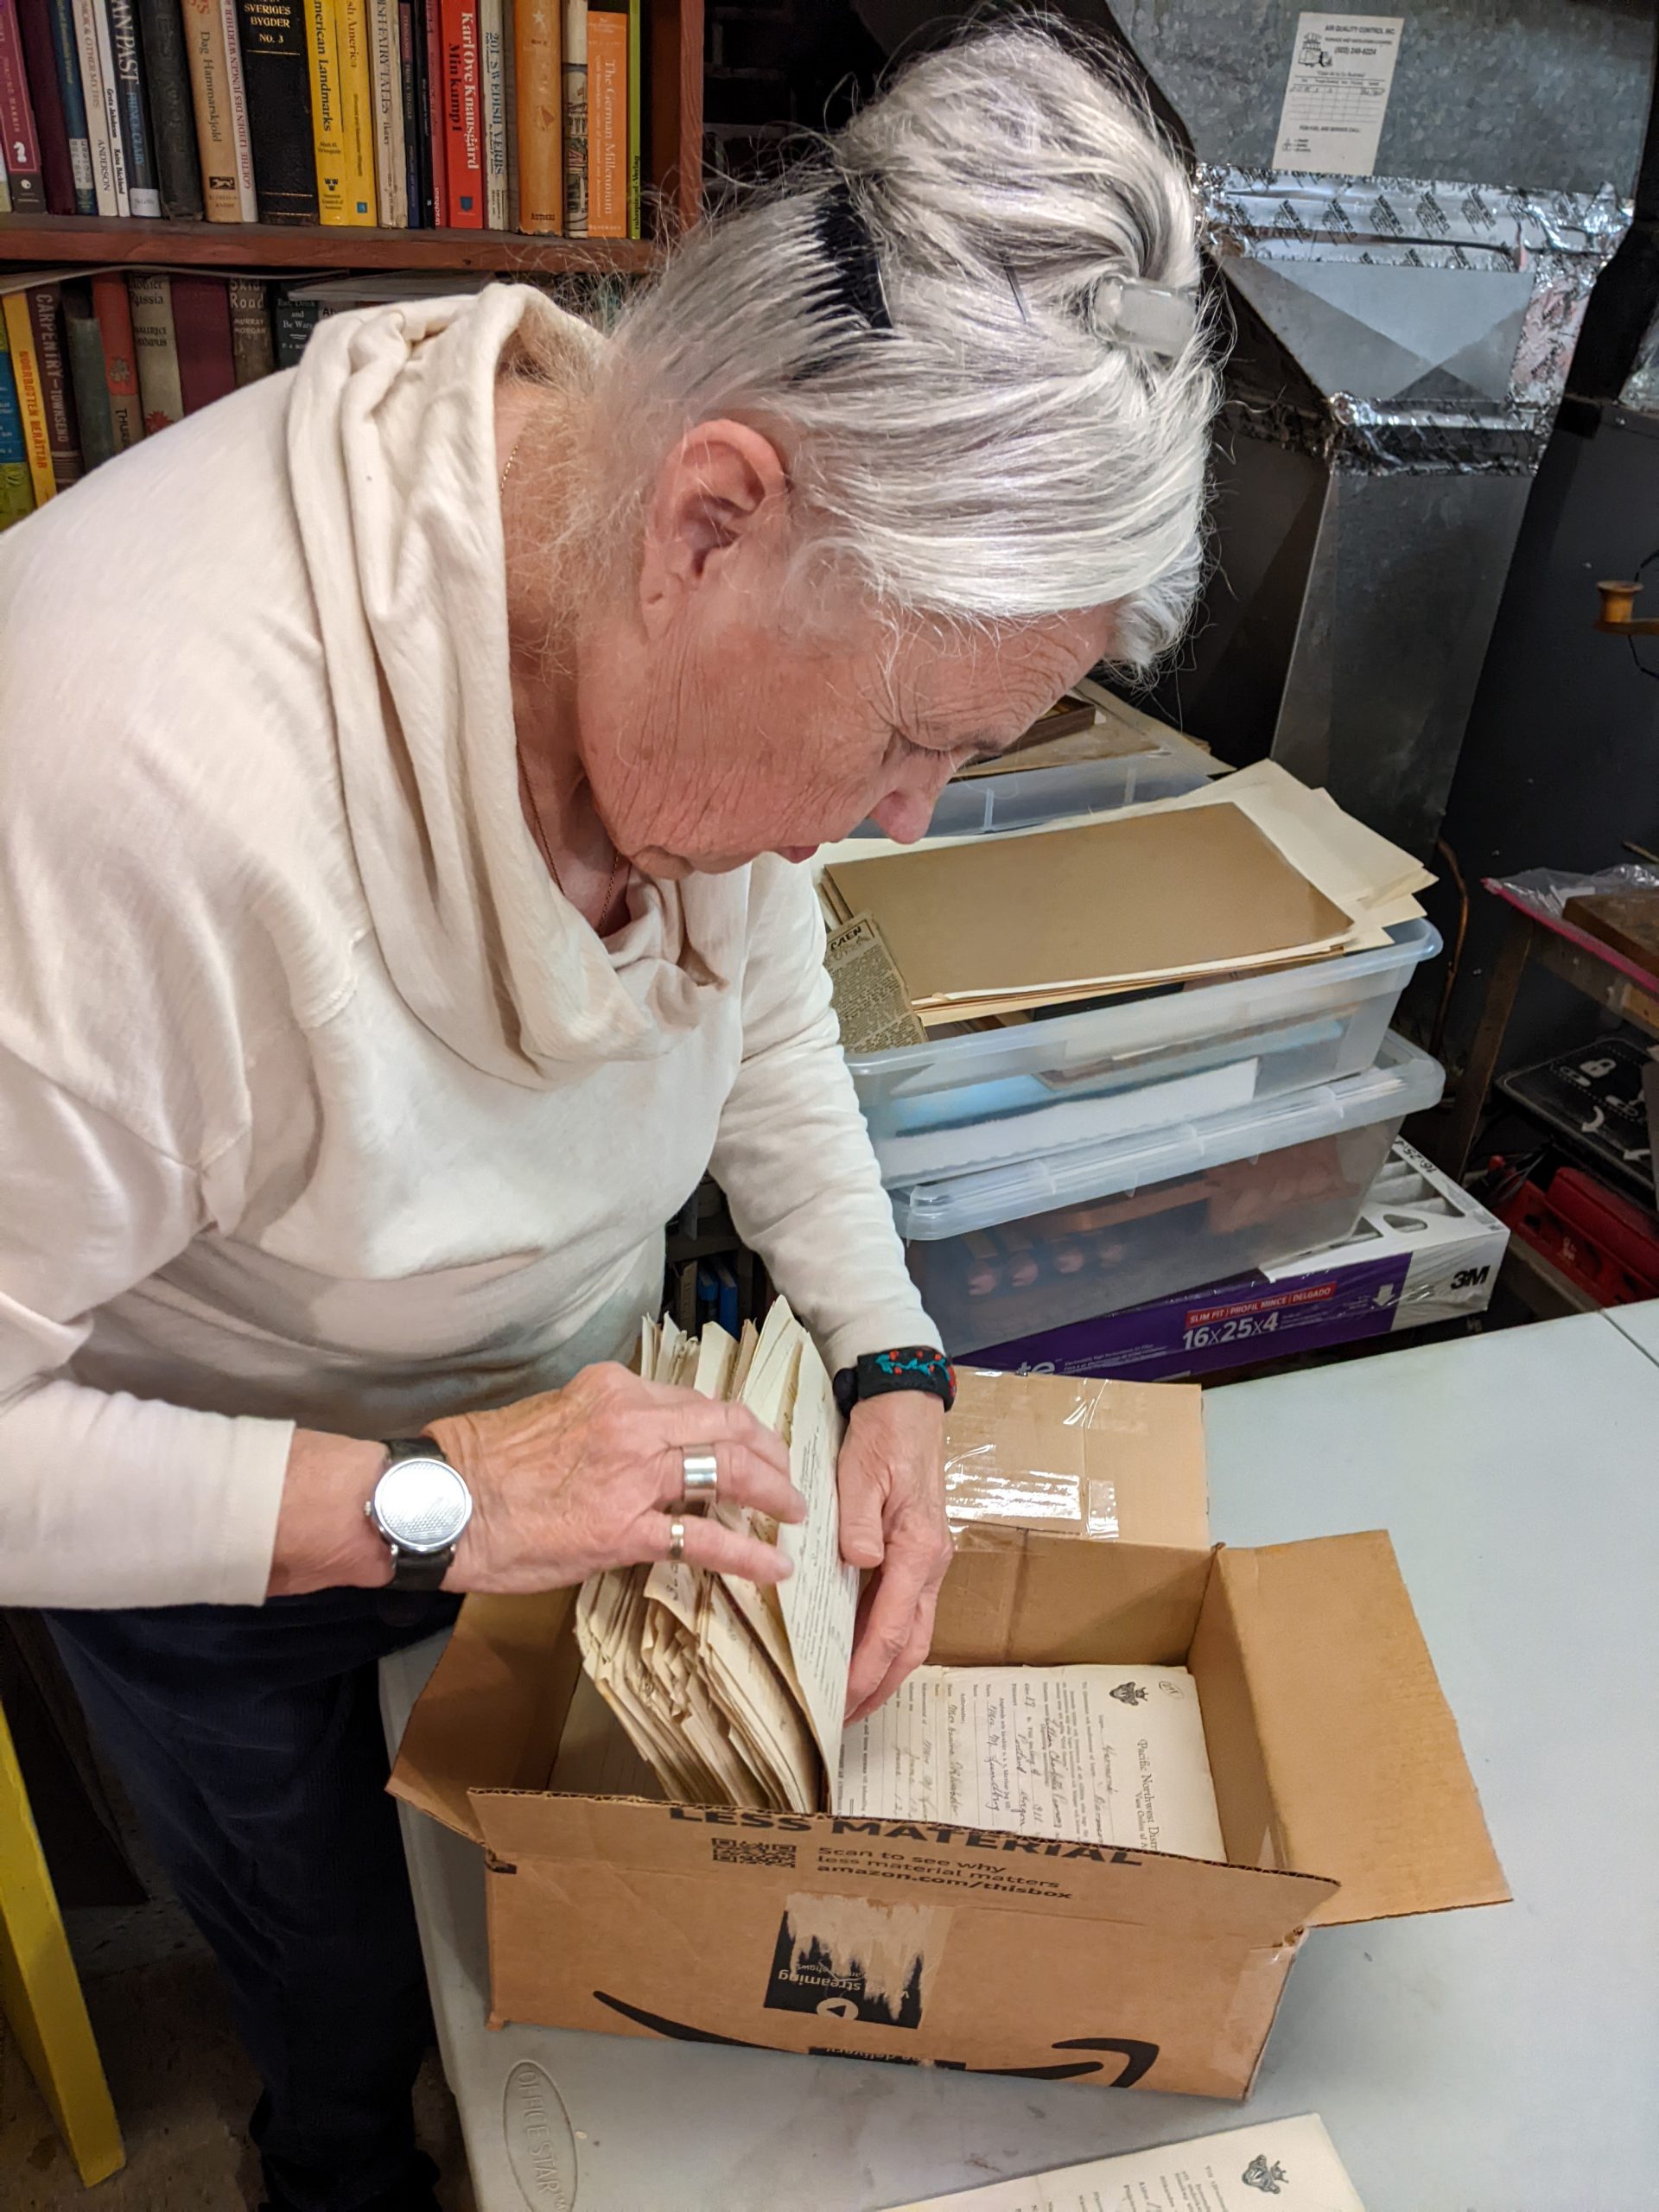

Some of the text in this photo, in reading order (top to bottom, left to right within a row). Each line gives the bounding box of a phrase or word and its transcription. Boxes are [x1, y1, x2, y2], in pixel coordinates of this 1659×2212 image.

[245, 3, 292, 16] SVERIGES
[250, 16, 291, 29] BYGDER
[200, 31, 211, 54] Dag
[225, 9, 237, 54] WERTHER
[278, 34, 284, 43] 3
[348, 18, 359, 67] America
[378, 26, 389, 65] FAIRY
[85, 37, 96, 72] OTHER
[117, 35, 139, 85] PAST
[315, 0, 332, 131] merican Landmarks
[449, 43, 461, 75] Min
[88, 73, 100, 109] MYTHS
[229, 55, 242, 94] JUNGEN
[380, 72, 391, 114] TALES
[461, 12, 479, 169] Karl Ove Knausgård
[235, 96, 244, 112] DES
[449, 79, 462, 123] kamp
[490, 32, 503, 175] 201 SWEDISH VERBS
[604, 60, 616, 214] The German Millennium
[98, 139, 110, 191] ANDERSON
[241, 152, 251, 189] GOETHE
[230, 293, 264, 309] Road
[283, 320, 293, 328] Be
[19, 351, 38, 416] NORRBOTTEN
[1450, 1265, 1491, 1290] 3M
[1190, 1287, 1331, 1324] SLIM FIT PROFIL MINCE DELGADO
[1182, 1312, 1279, 1350] 16x25x4
[1137, 1739, 1151, 1771] Pacific
[1141, 1774, 1155, 1823] Northwest
[670, 1807, 1142, 1867] LESS MATERIAL
[818, 1855, 1060, 1889] less material matters
[819, 1846, 1007, 1874] Scan to see why
[817, 1866, 1073, 1899] amazon.com/thisbox
[779, 1969, 861, 1991] streaming
[518, 2070, 560, 2194] OFFICE STAR
